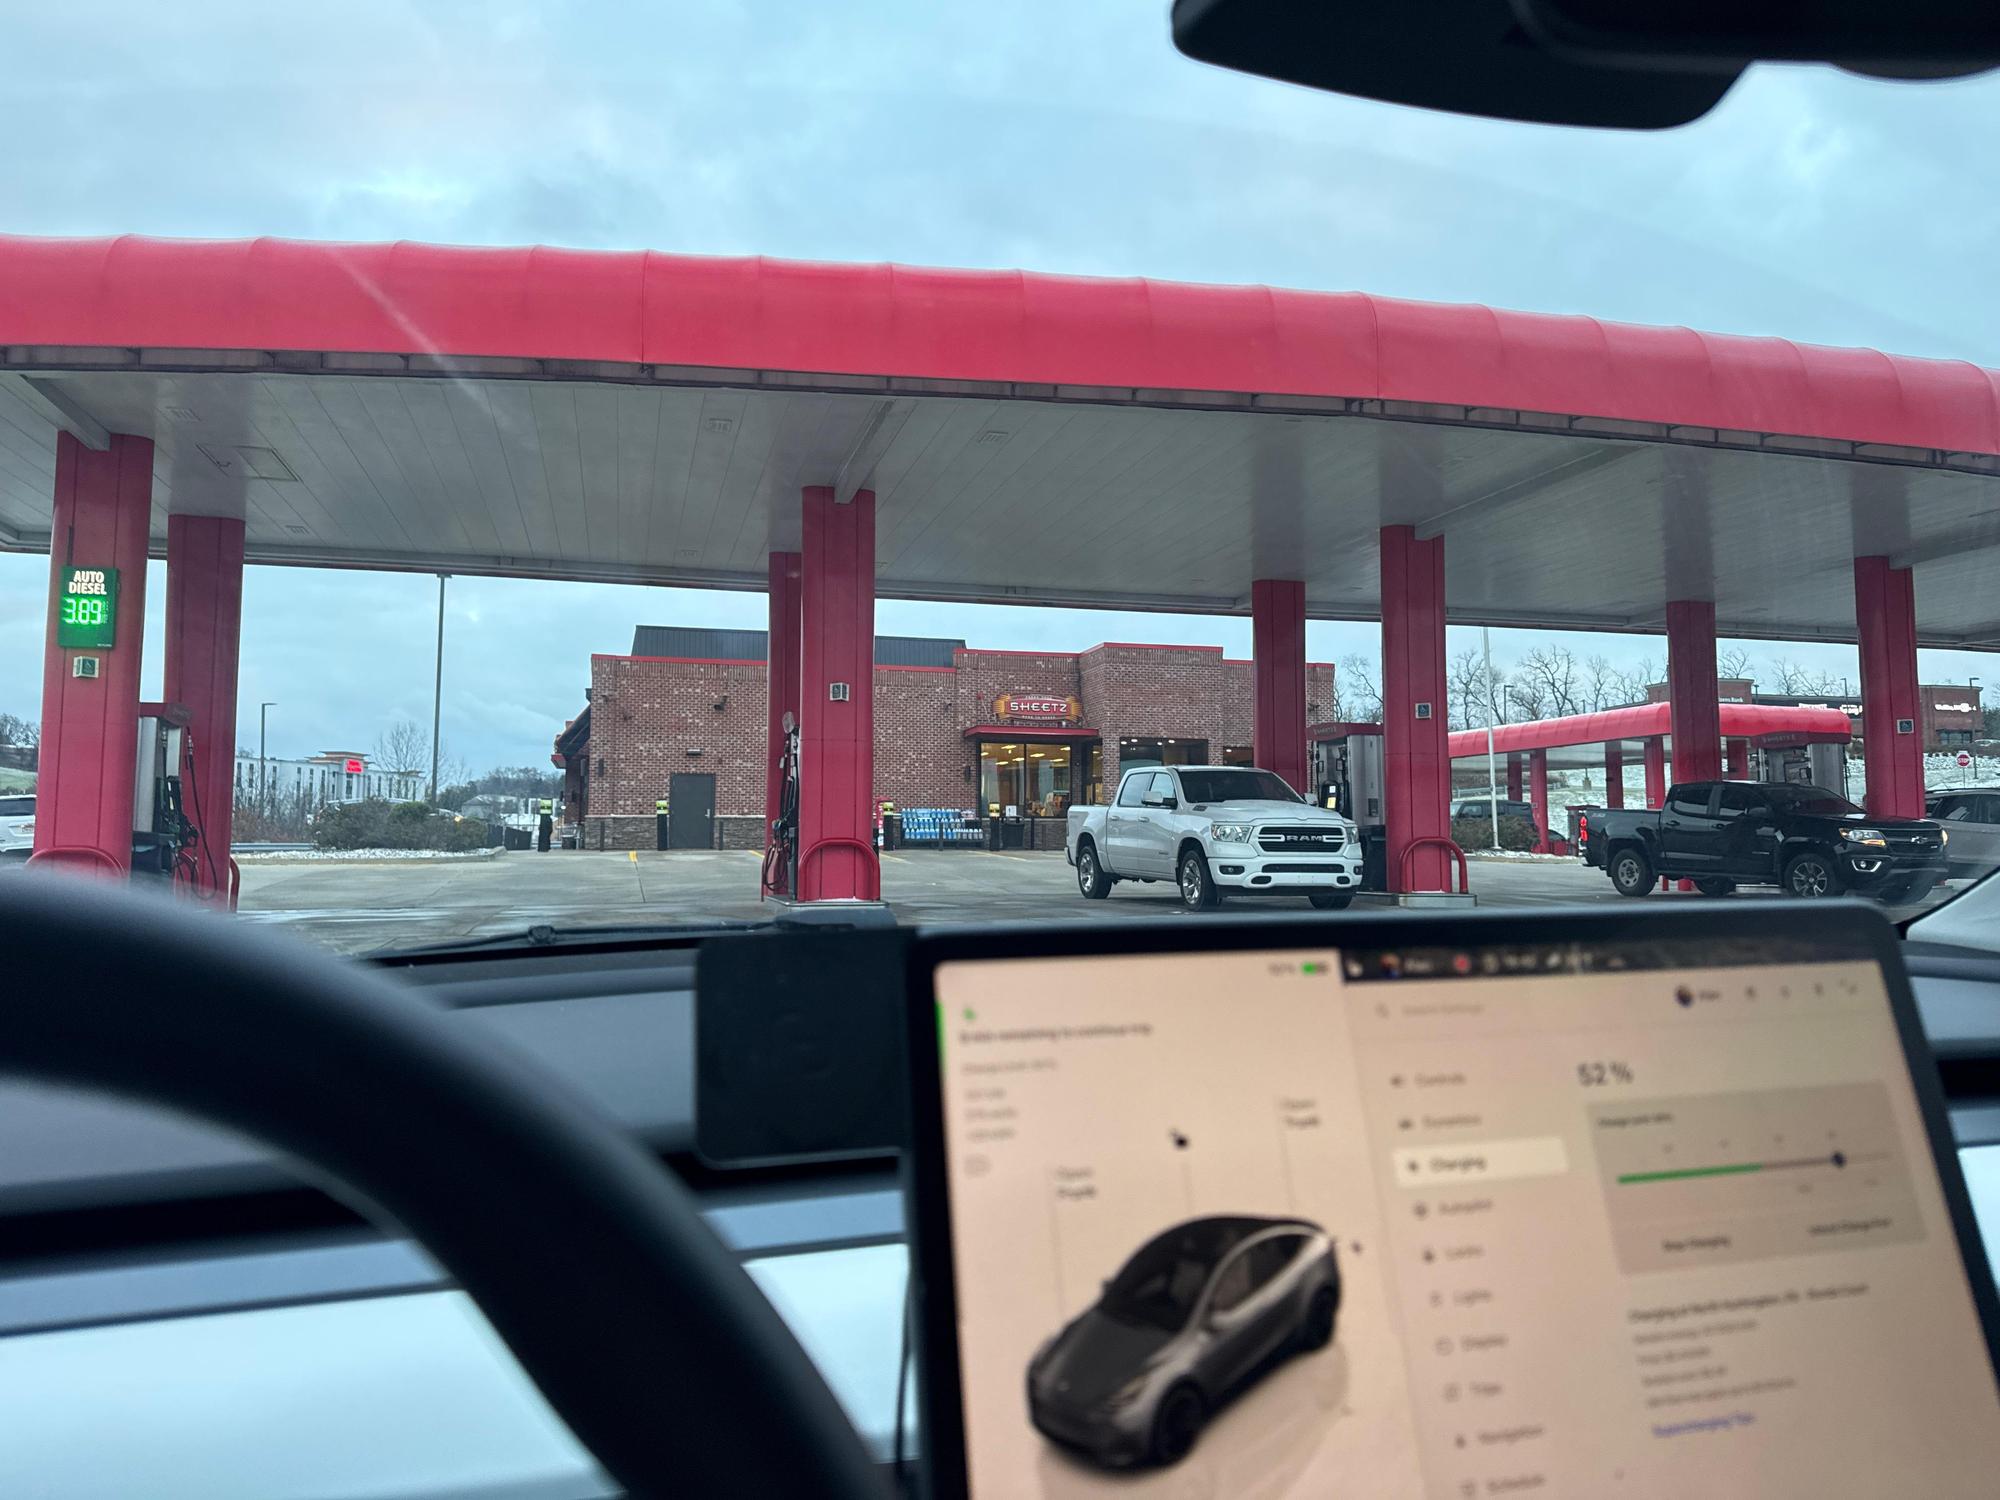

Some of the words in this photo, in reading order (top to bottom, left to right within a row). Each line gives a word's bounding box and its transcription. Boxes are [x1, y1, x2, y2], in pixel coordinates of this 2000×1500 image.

[73, 570, 105, 583] AUTO
[68, 581, 107, 595] DIESEL
[63, 597, 102, 625] 3.89
[1010, 702, 1067, 712] SHEETZ
